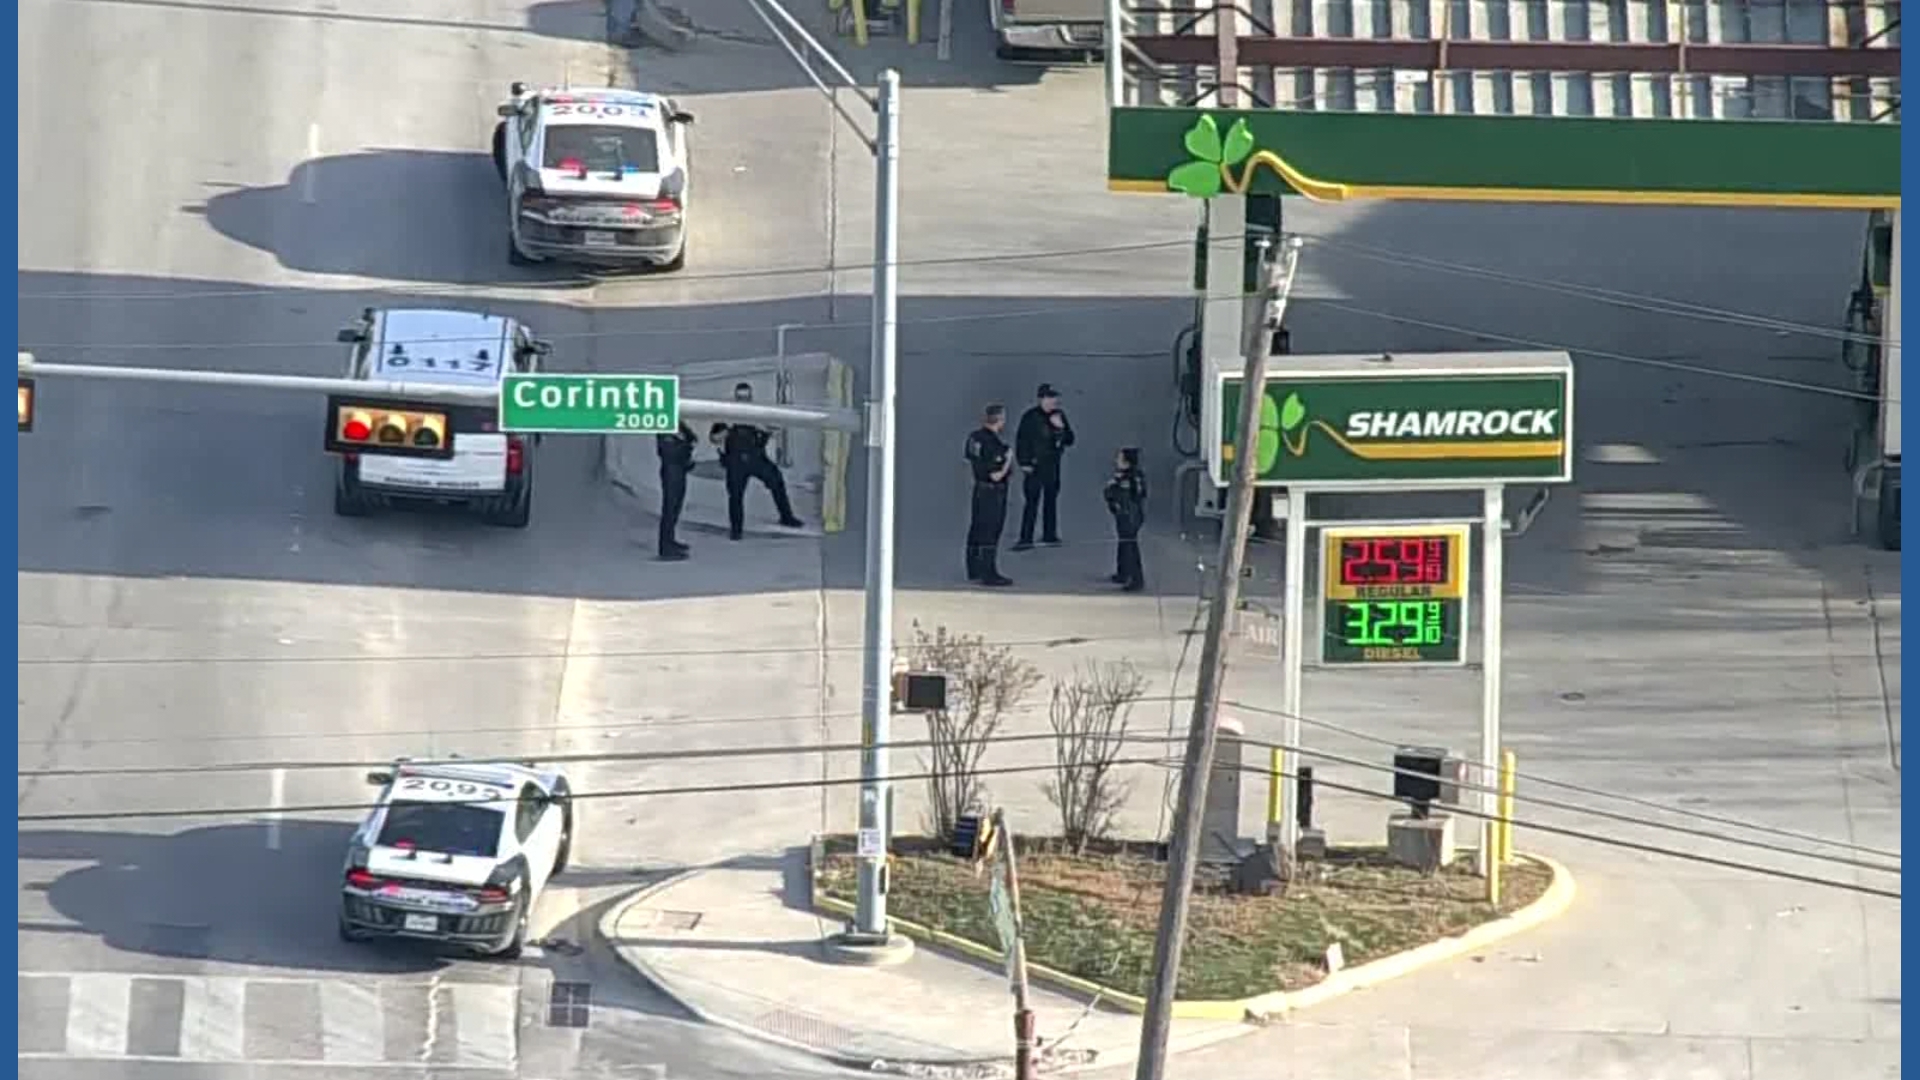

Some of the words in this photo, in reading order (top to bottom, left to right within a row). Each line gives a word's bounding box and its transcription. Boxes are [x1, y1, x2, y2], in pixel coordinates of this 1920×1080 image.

[387, 356, 492, 372] 0117
[513, 379, 664, 409] Corinth
[615, 413, 669, 429] 2000
[1346, 409, 1558, 437] SHAMROCK
[1355, 586, 1432, 597] REGULAR
[1363, 647, 1421, 660] DIESEL
